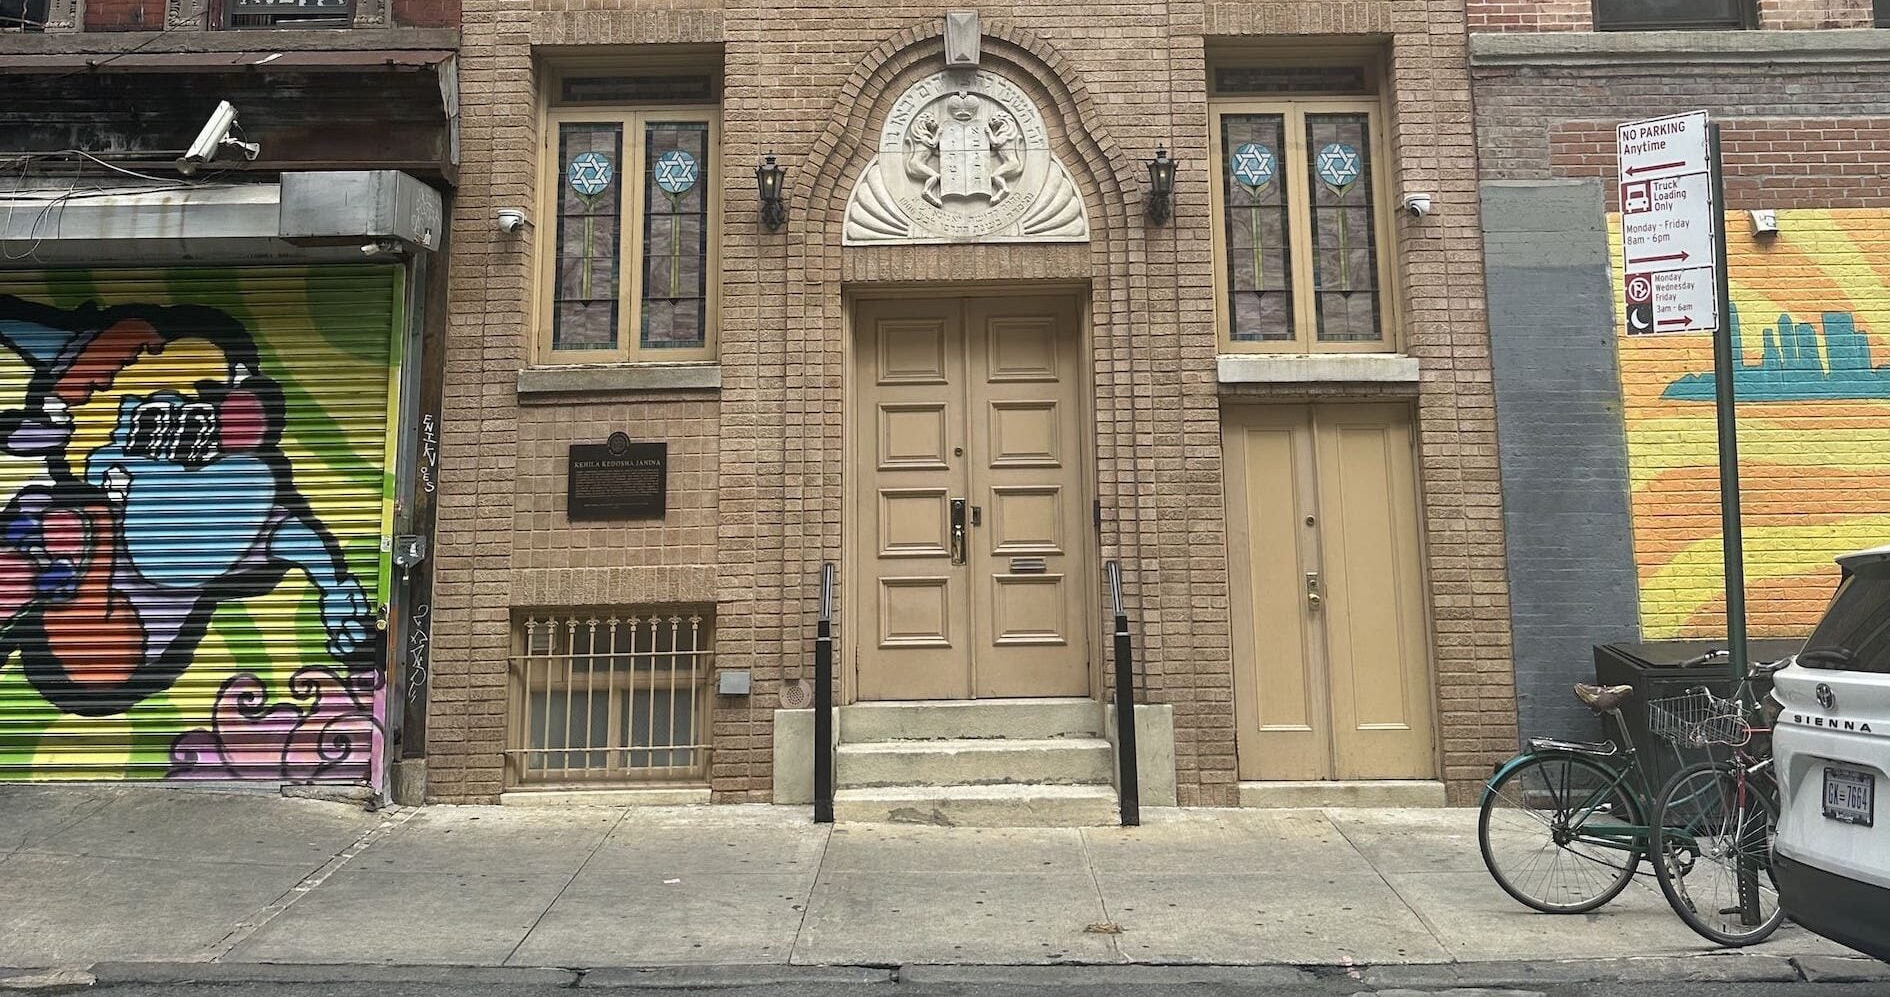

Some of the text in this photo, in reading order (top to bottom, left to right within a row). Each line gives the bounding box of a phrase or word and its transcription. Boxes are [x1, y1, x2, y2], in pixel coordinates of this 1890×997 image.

[1622, 121, 1686, 142] NO PARKING
[1624, 140, 1666, 155] Anytime
[1654, 182, 1678, 191] Truck
[1654, 189, 1687, 201] Loading
[1654, 202, 1673, 212] Only
[1626, 222, 1657, 234] Monday
[1664, 219, 1690, 231] Friday
[1627, 234, 1645, 245] 8am
[1652, 233, 1671, 245] 6pm
[1654, 273, 1682, 284] Monday
[1655, 281, 1695, 292] Wednesday
[1655, 292, 1677, 303] Friday
[1656, 305, 1672, 314] 3am
[1677, 303, 1693, 311] 6am
[636, 459, 661, 467] JANINA
[1794, 714, 1872, 733] SIENNA
